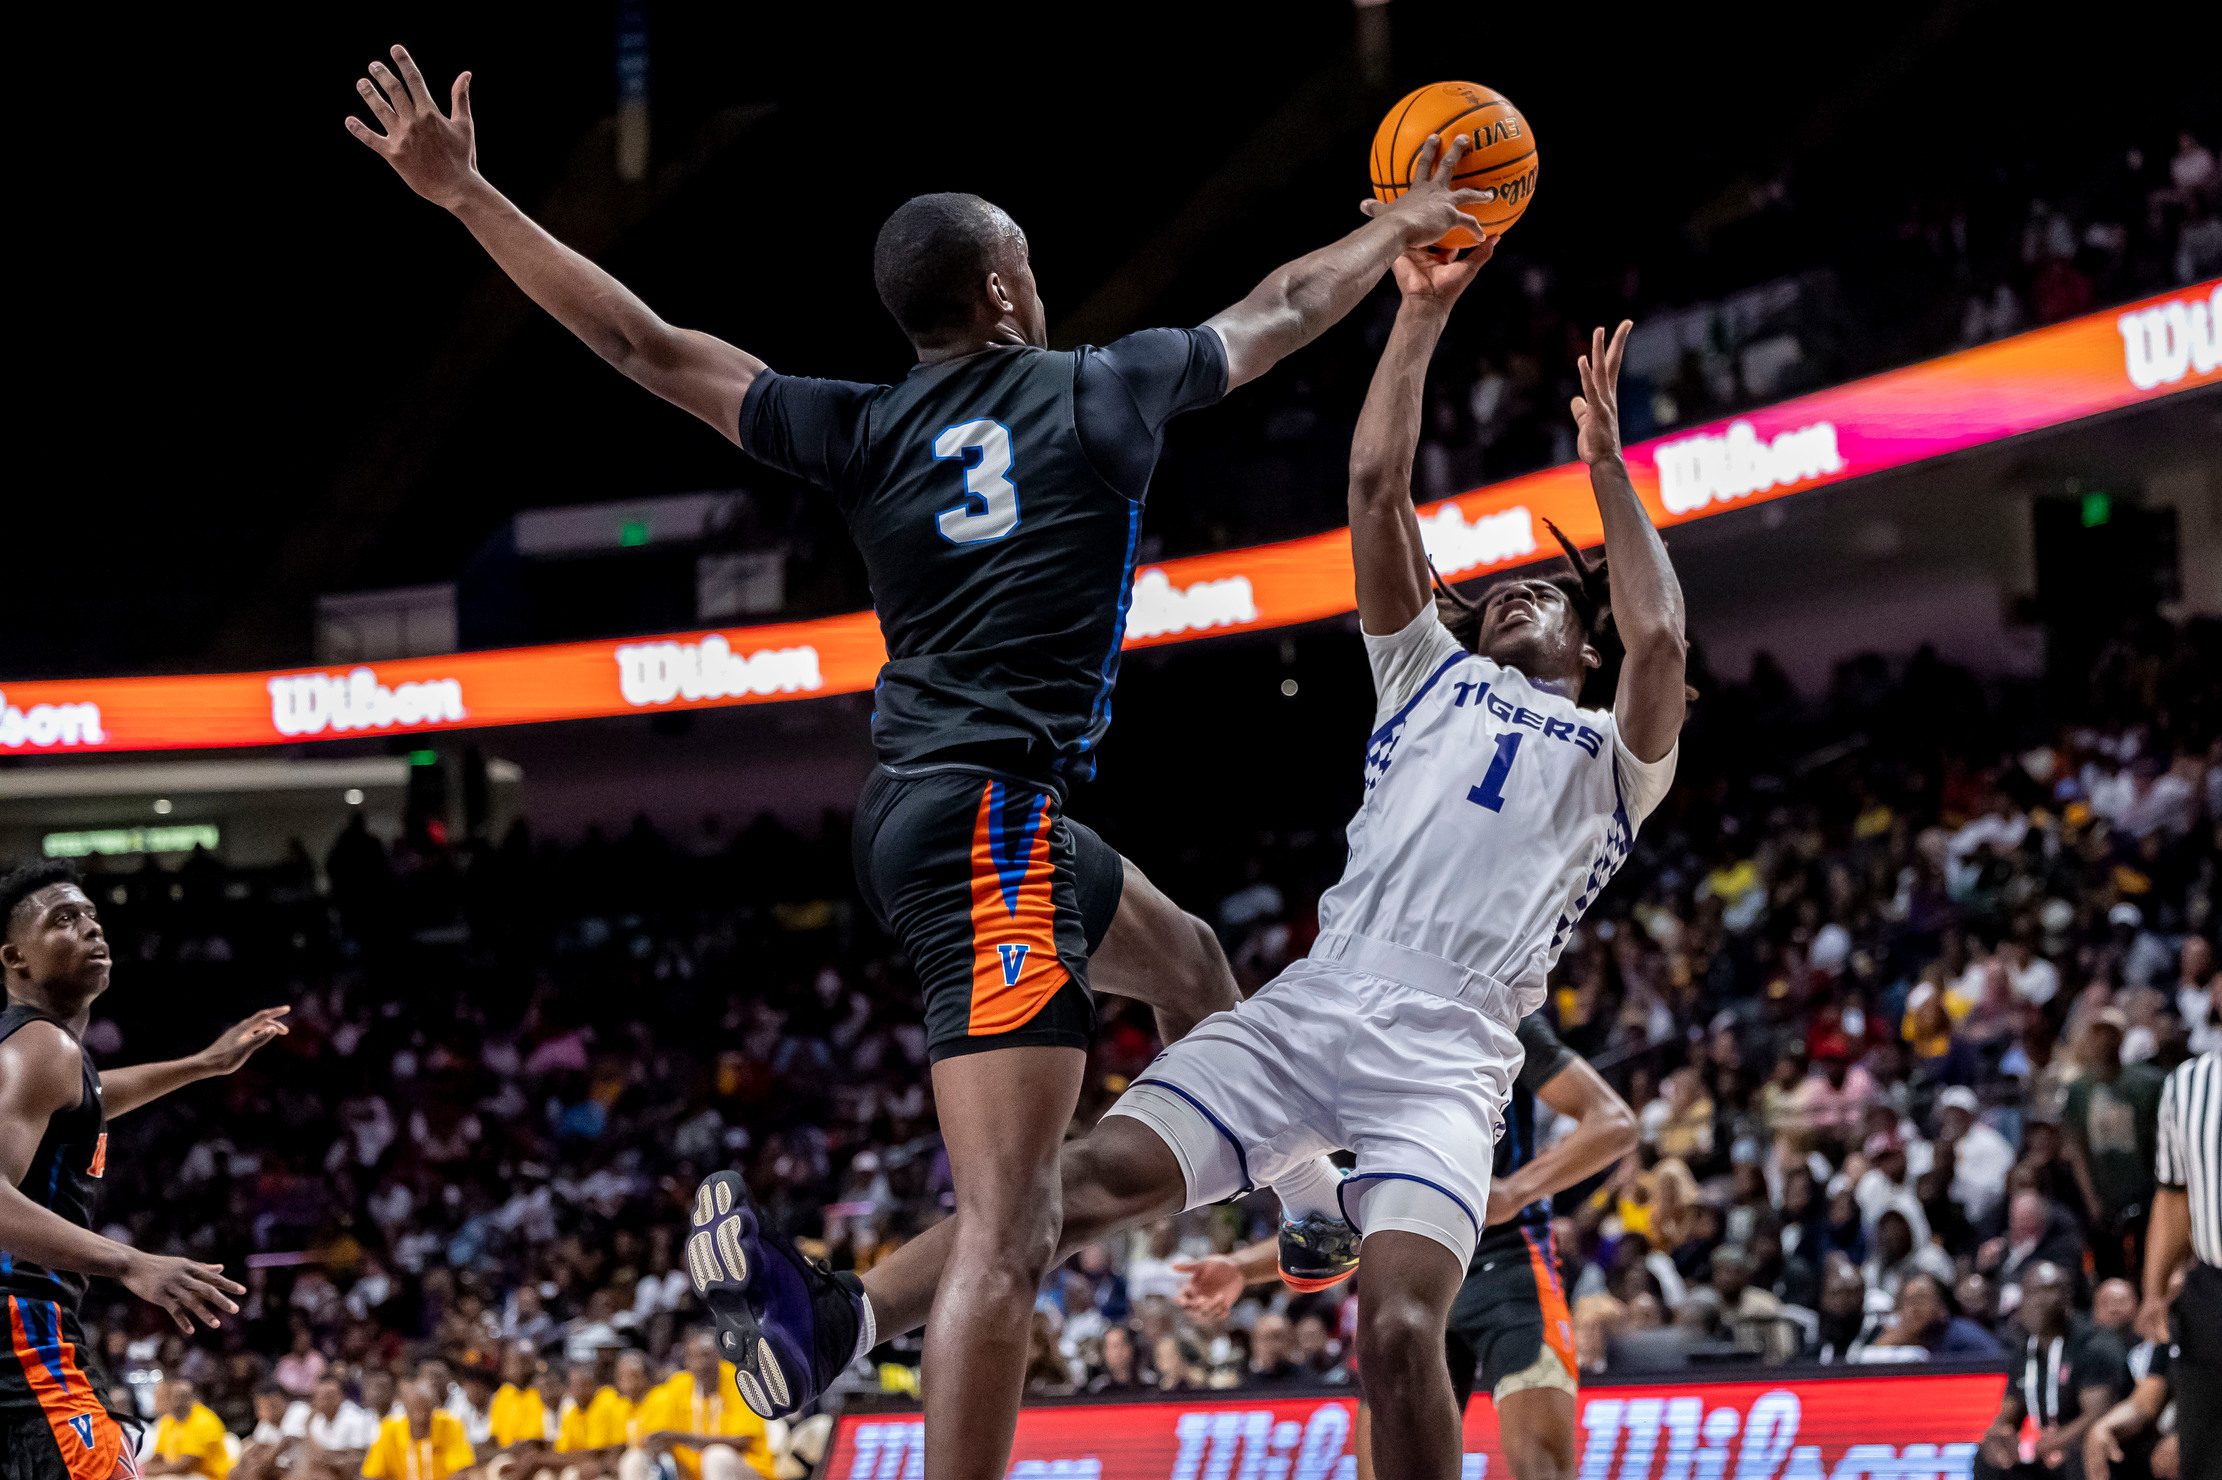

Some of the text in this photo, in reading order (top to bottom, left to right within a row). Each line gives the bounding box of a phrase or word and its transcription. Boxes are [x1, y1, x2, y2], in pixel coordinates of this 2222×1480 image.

[1473, 117, 1521, 151] EVO
[1474, 164, 1538, 206] Wilso
[932, 417, 1021, 545] 3
[1653, 420, 1844, 515] Wilson
[1416, 502, 1536, 578] ilson
[267, 667, 465, 736] Wilson
[614, 634, 823, 706] Wilson
[0, 689, 103, 748] son
[1454, 682, 1604, 759] TIGERS
[1466, 732, 1523, 813] 1
[997, 944, 1030, 986] V
[68, 1412, 95, 1450] V
[1172, 1402, 1488, 1480] Wil
